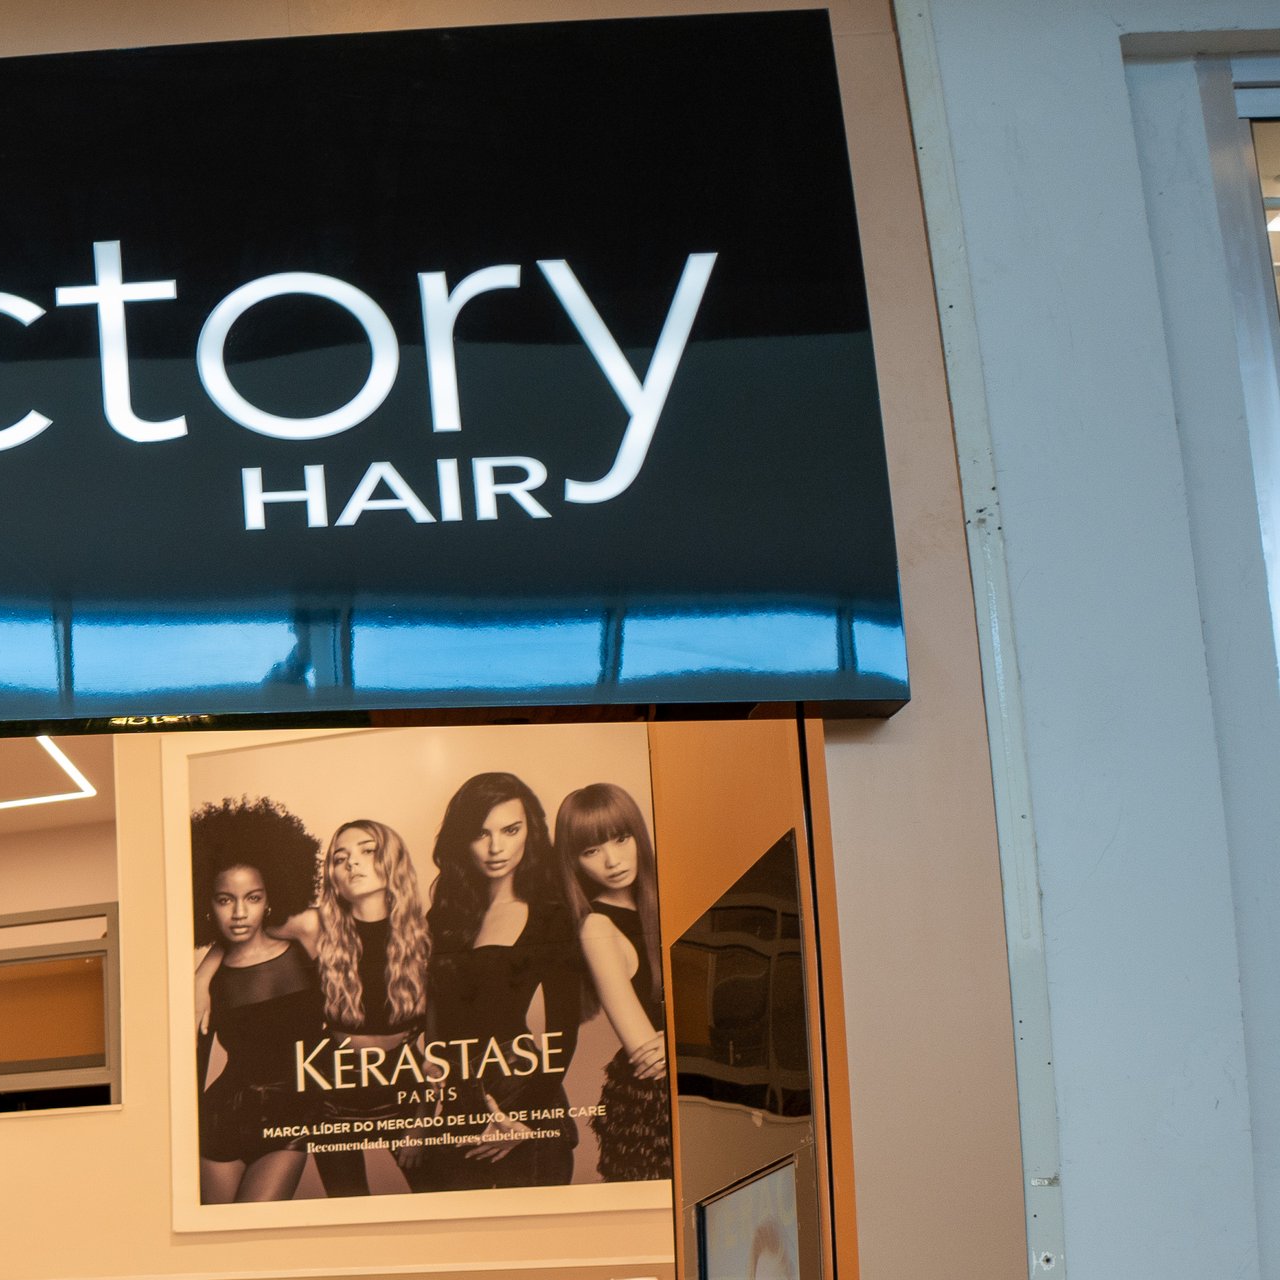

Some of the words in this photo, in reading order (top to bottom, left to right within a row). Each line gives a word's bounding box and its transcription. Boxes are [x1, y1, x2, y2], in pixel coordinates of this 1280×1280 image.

[241, 455, 553, 530] HAIR
[295, 1031, 565, 1093] KÉRASTASE
[397, 1086, 458, 1104] PARIS
[263, 1123, 310, 1138] MARCA
[312, 1120, 351, 1136] LÍDER
[353, 1120, 375, 1133] DO
[377, 1116, 444, 1132] MERCADO
[447, 1114, 465, 1127] DE
[468, 1111, 505, 1125] LUXO
[509, 1109, 528, 1122] DE
[531, 1107, 564, 1120] HAIR
[568, 1104, 606, 1118] CARE
[306, 1137, 389, 1154] Recomendada
[391, 1135, 423, 1152] pelos
[424, 1132, 480, 1147] melhores
[481, 1127, 561, 1144] cabeleireiros
